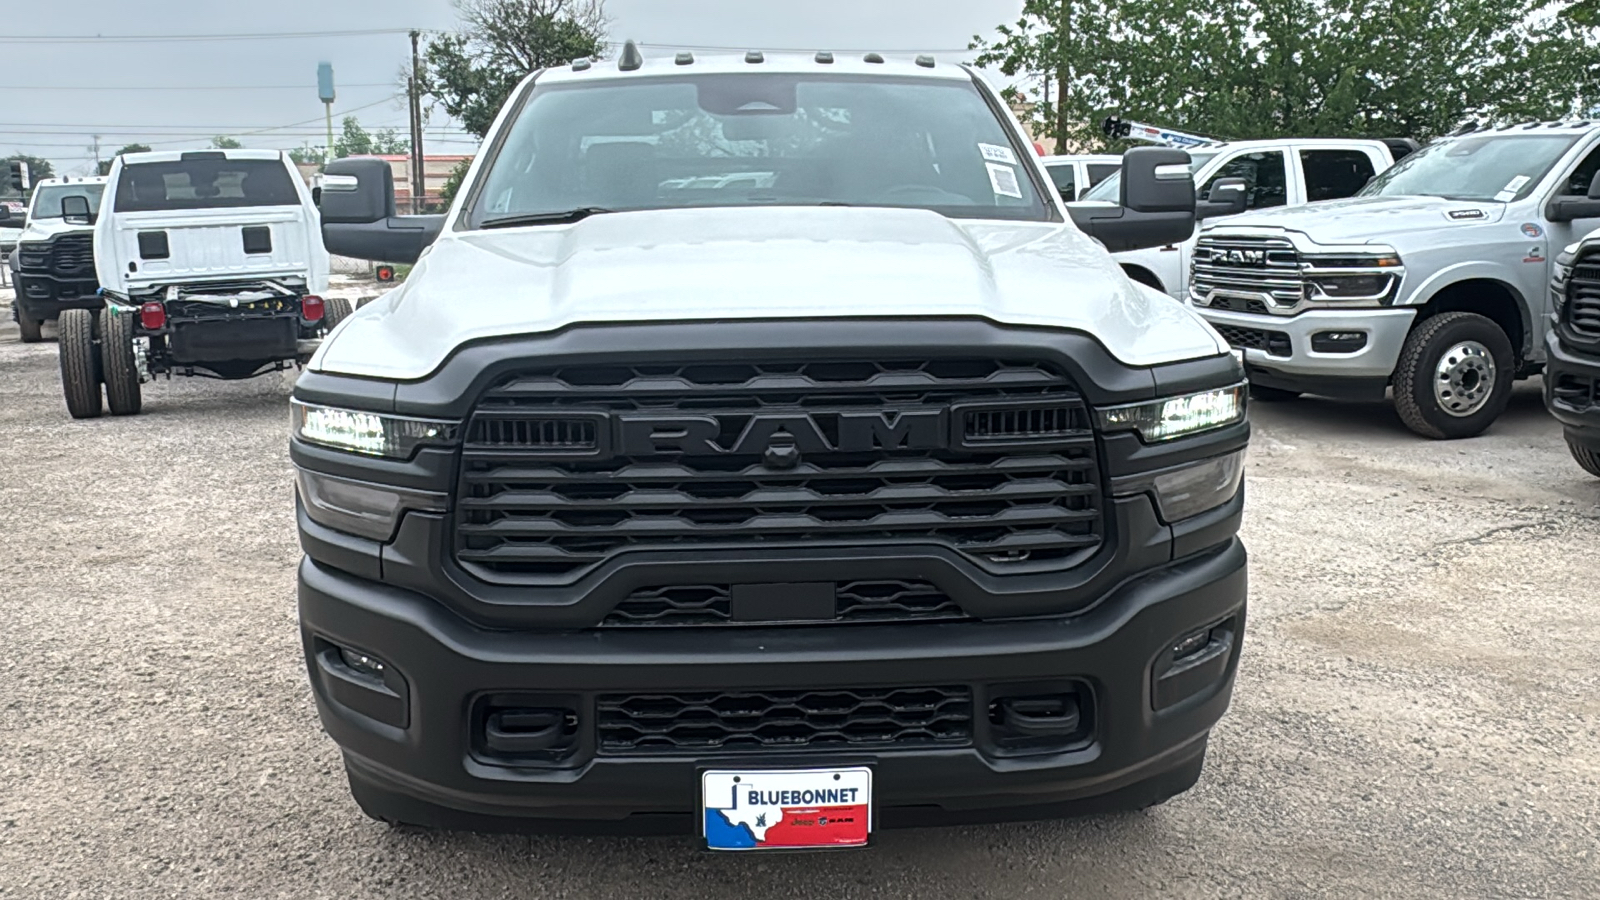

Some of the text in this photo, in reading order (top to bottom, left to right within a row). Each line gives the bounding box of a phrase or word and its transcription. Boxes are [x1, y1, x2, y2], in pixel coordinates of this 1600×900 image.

[1211, 248, 1264, 264] RAM
[619, 410, 942, 454] RAM
[748, 788, 858, 805] BLUEBONNET
